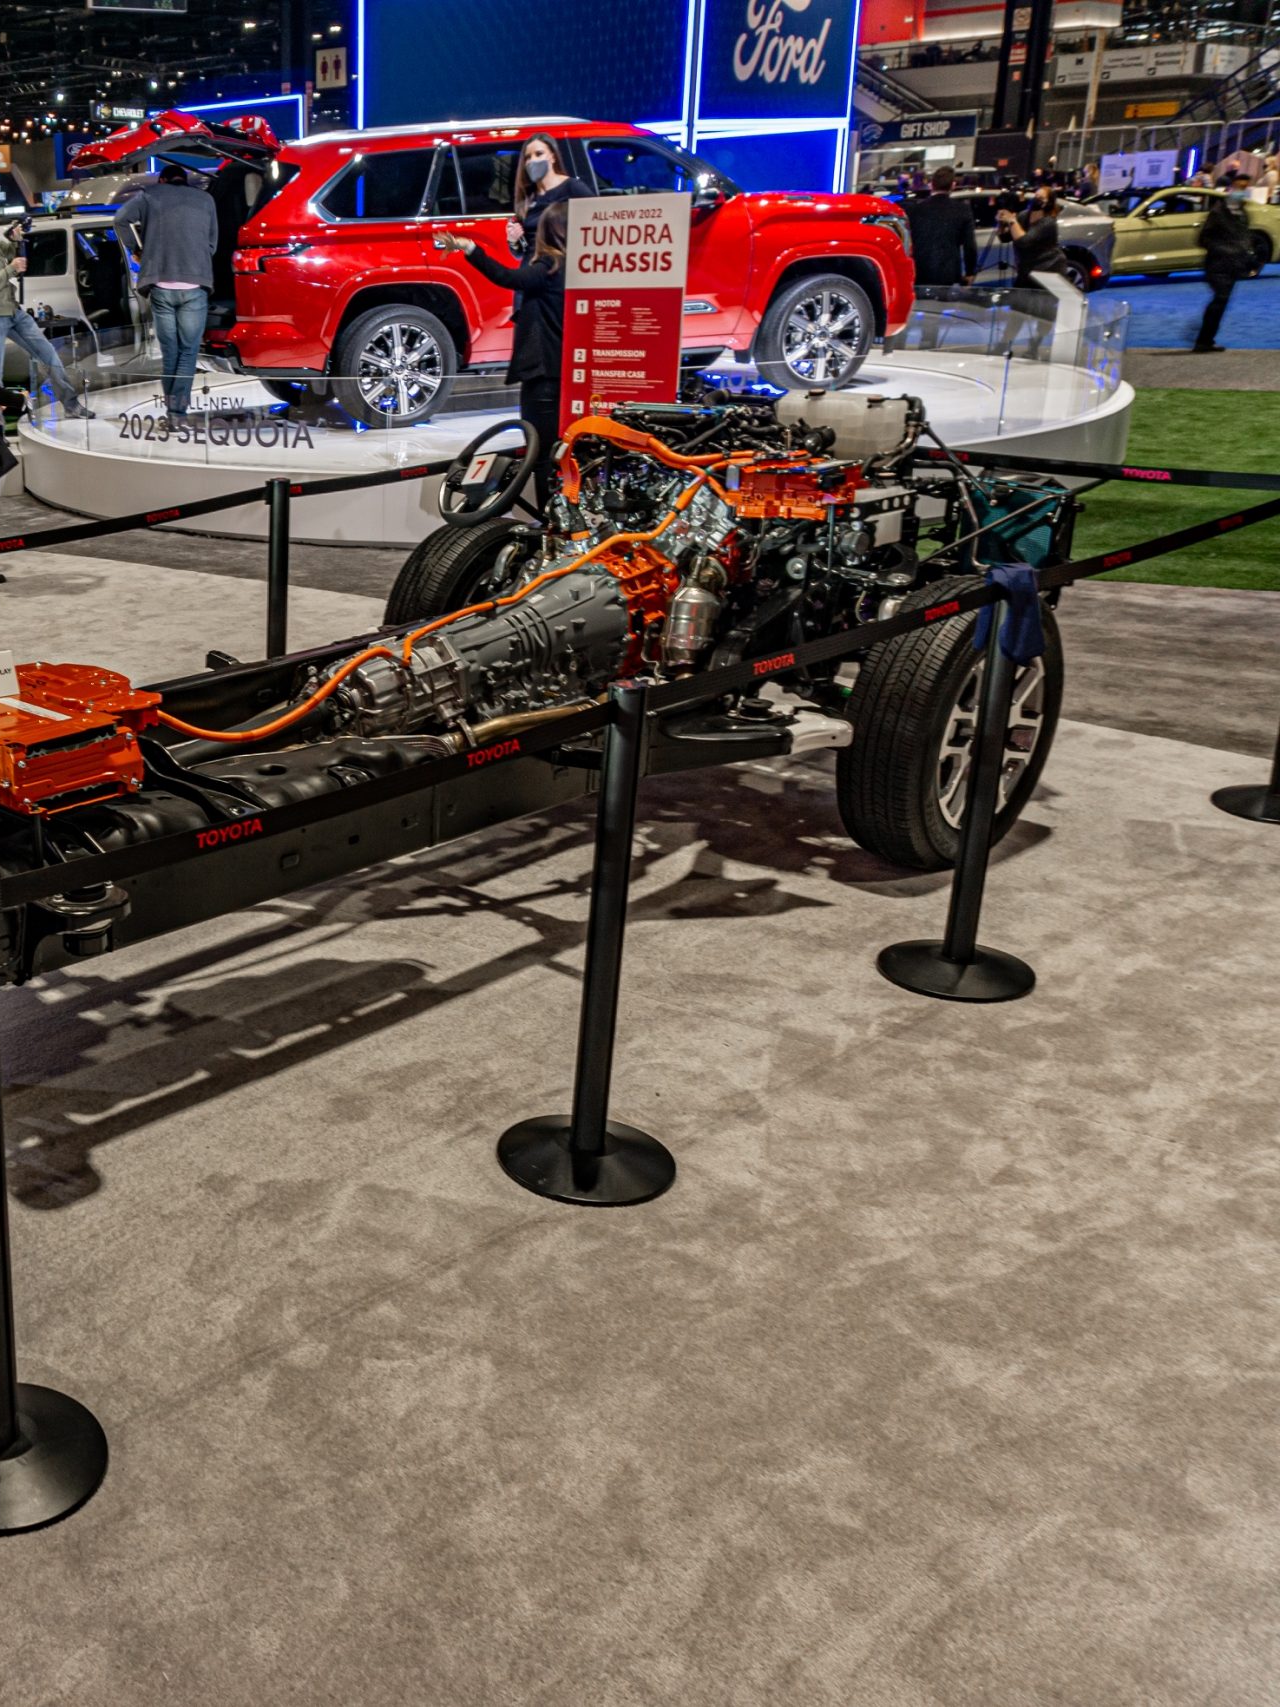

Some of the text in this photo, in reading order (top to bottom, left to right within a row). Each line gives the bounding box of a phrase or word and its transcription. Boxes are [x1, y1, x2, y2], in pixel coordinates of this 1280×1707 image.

[733, 0, 832, 84] Ford
[901, 120, 950, 138] GIFT SHOP
[592, 208, 663, 221] ALL-NEW 2022
[580, 223, 673, 247] TUNDRA
[578, 251, 673, 274] CHASSIS
[594, 300, 622, 308] MOTOR
[577, 351, 584, 361] 2
[592, 349, 646, 358] TRANSMISSION
[576, 369, 646, 381] 3 TRANSFER CASE
[575, 402, 581, 412] 4
[119, 412, 314, 449] 2023 SEQUOIA
[470, 460, 488, 480] 7
[1122, 467, 1172, 481] TOYOTA
[145, 508, 181, 523] TOYOTA
[923, 600, 961, 622] TOYOTA
[752, 652, 796, 676] TOYOTA
[466, 737, 521, 768] TOYOTA
[195, 818, 263, 849] TOYOTA
